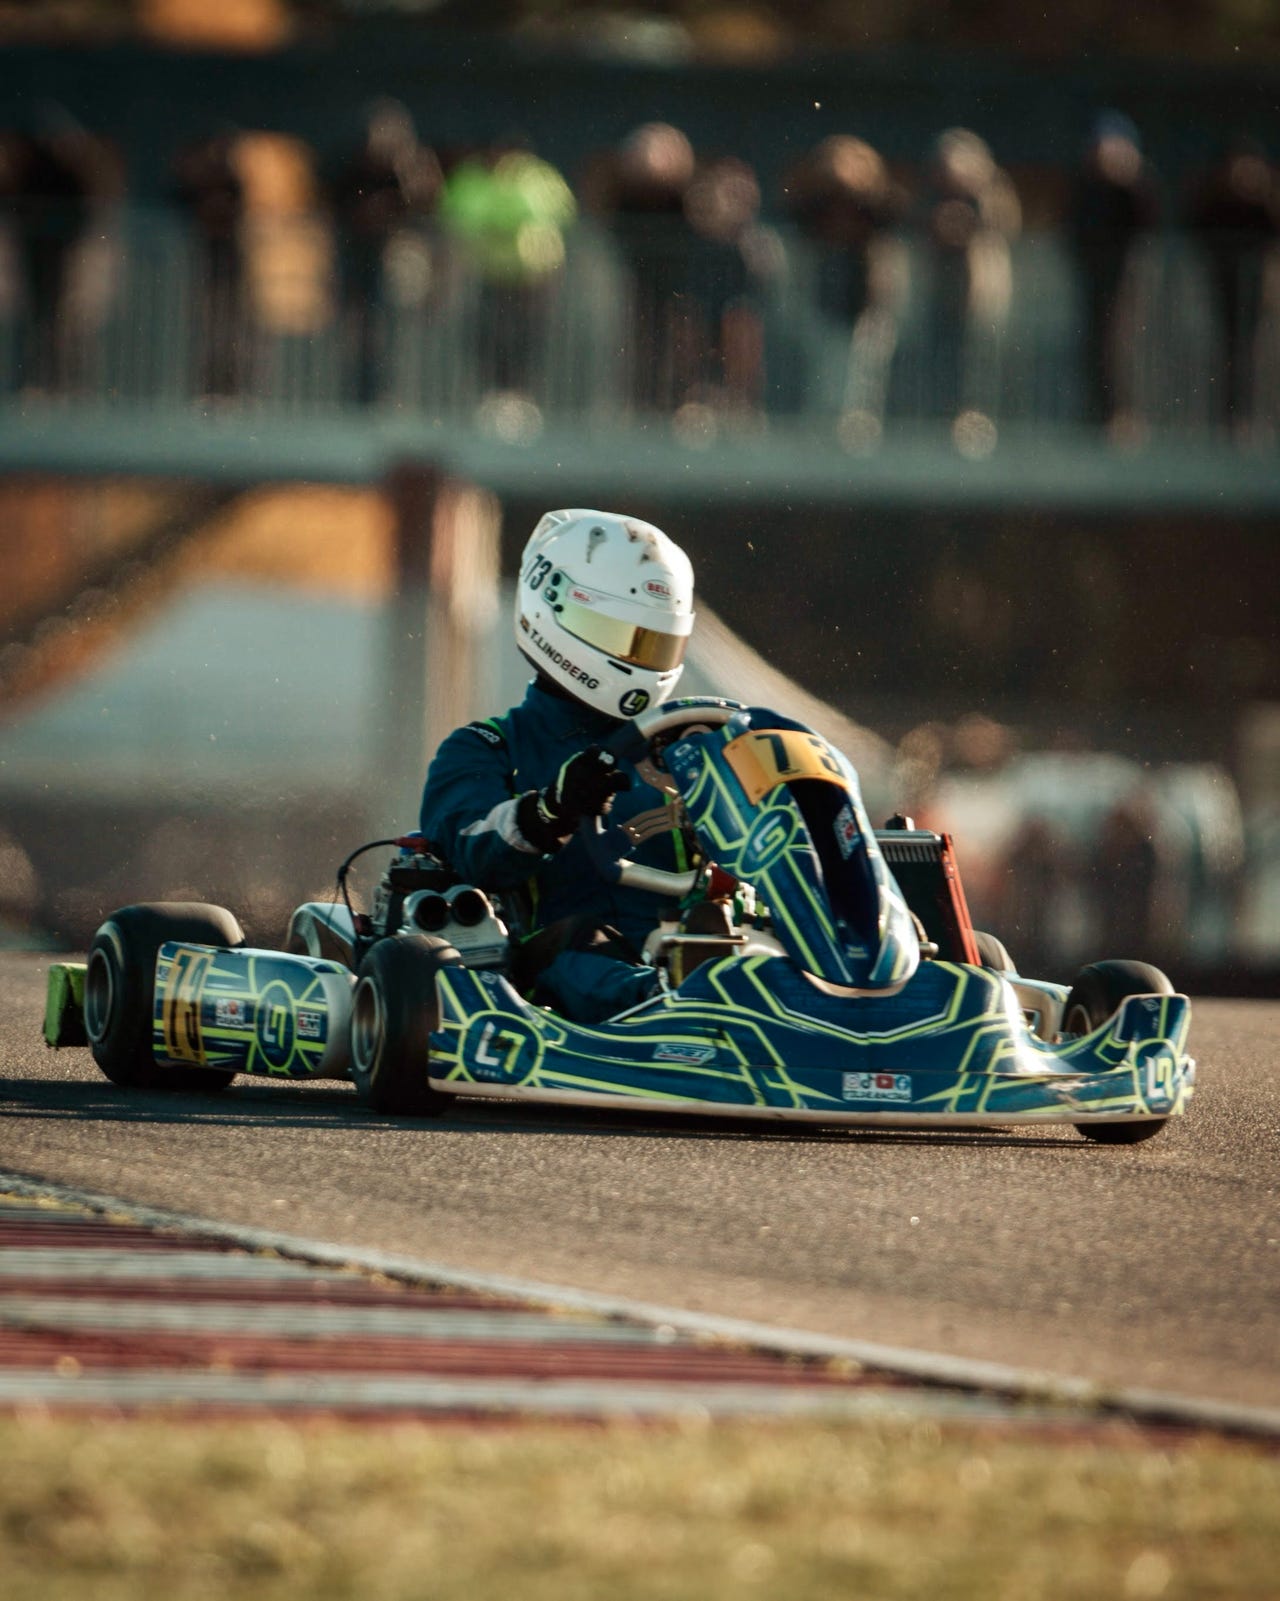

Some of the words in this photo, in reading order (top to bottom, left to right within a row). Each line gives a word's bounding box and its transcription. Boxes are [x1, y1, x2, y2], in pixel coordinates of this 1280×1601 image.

[524, 553, 553, 590] 73
[647, 582, 672, 596] BELL
[530, 629, 600, 690] T.LINDBERG
